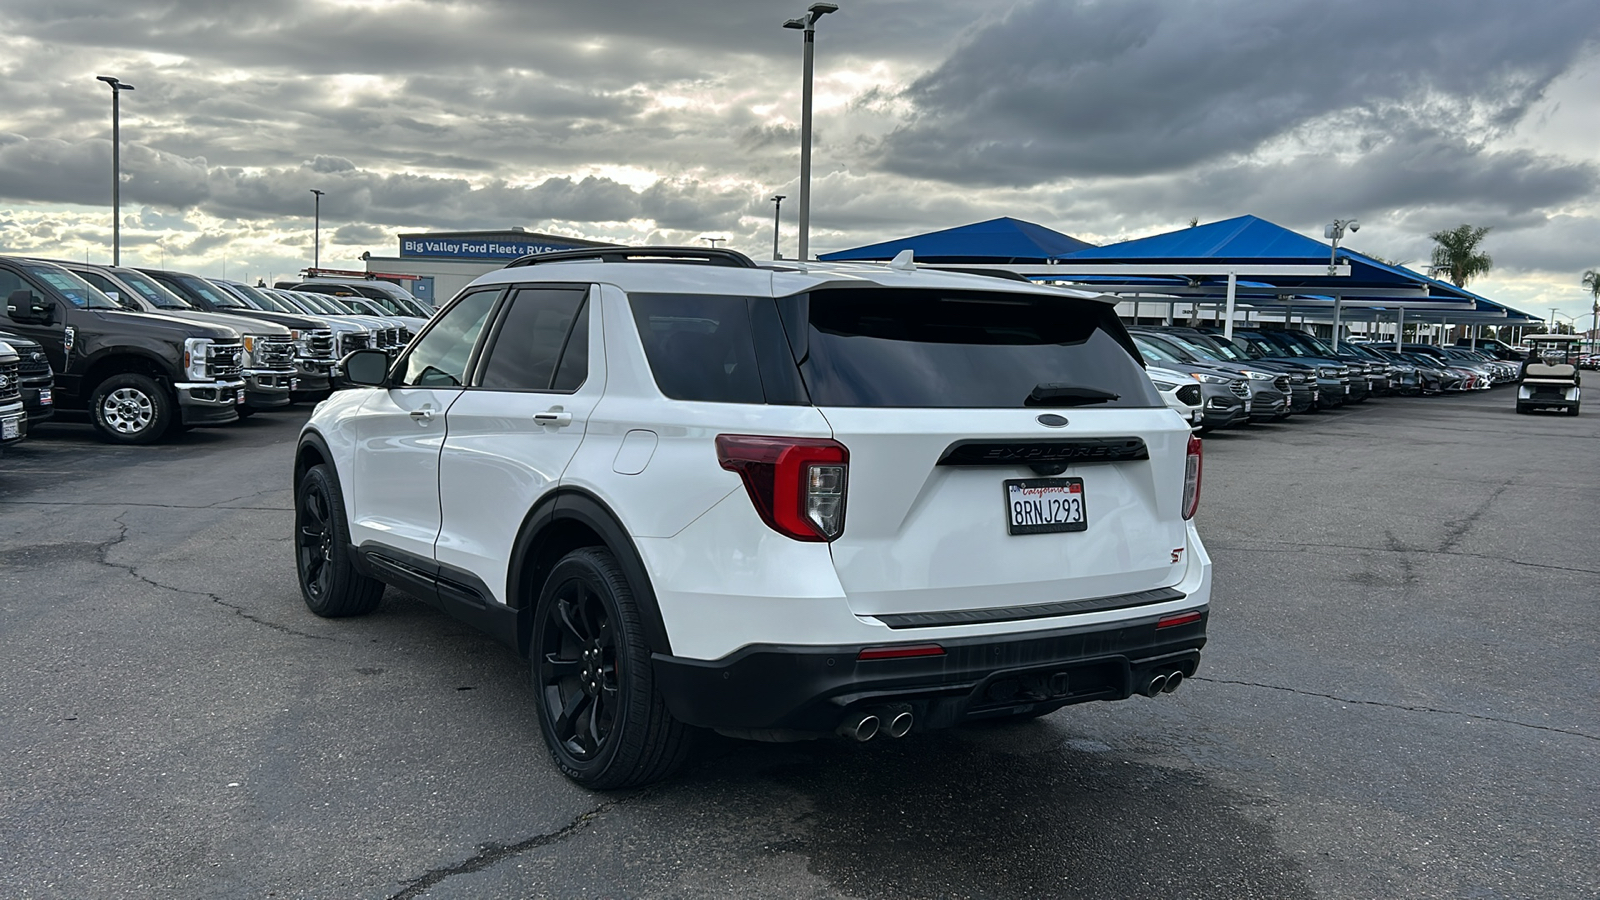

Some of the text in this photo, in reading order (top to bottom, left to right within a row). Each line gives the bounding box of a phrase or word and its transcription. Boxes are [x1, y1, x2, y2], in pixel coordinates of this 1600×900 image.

[405, 241, 424, 253] Big
[426, 241, 459, 254] Valley
[462, 243, 487, 253] Ford
[489, 244, 516, 254] Fleet
[527, 246, 543, 254] RV
[983, 445, 1123, 459] EXPLORER
[1014, 498, 1081, 525] 8RNJ293
[1170, 547, 1184, 564] ST
